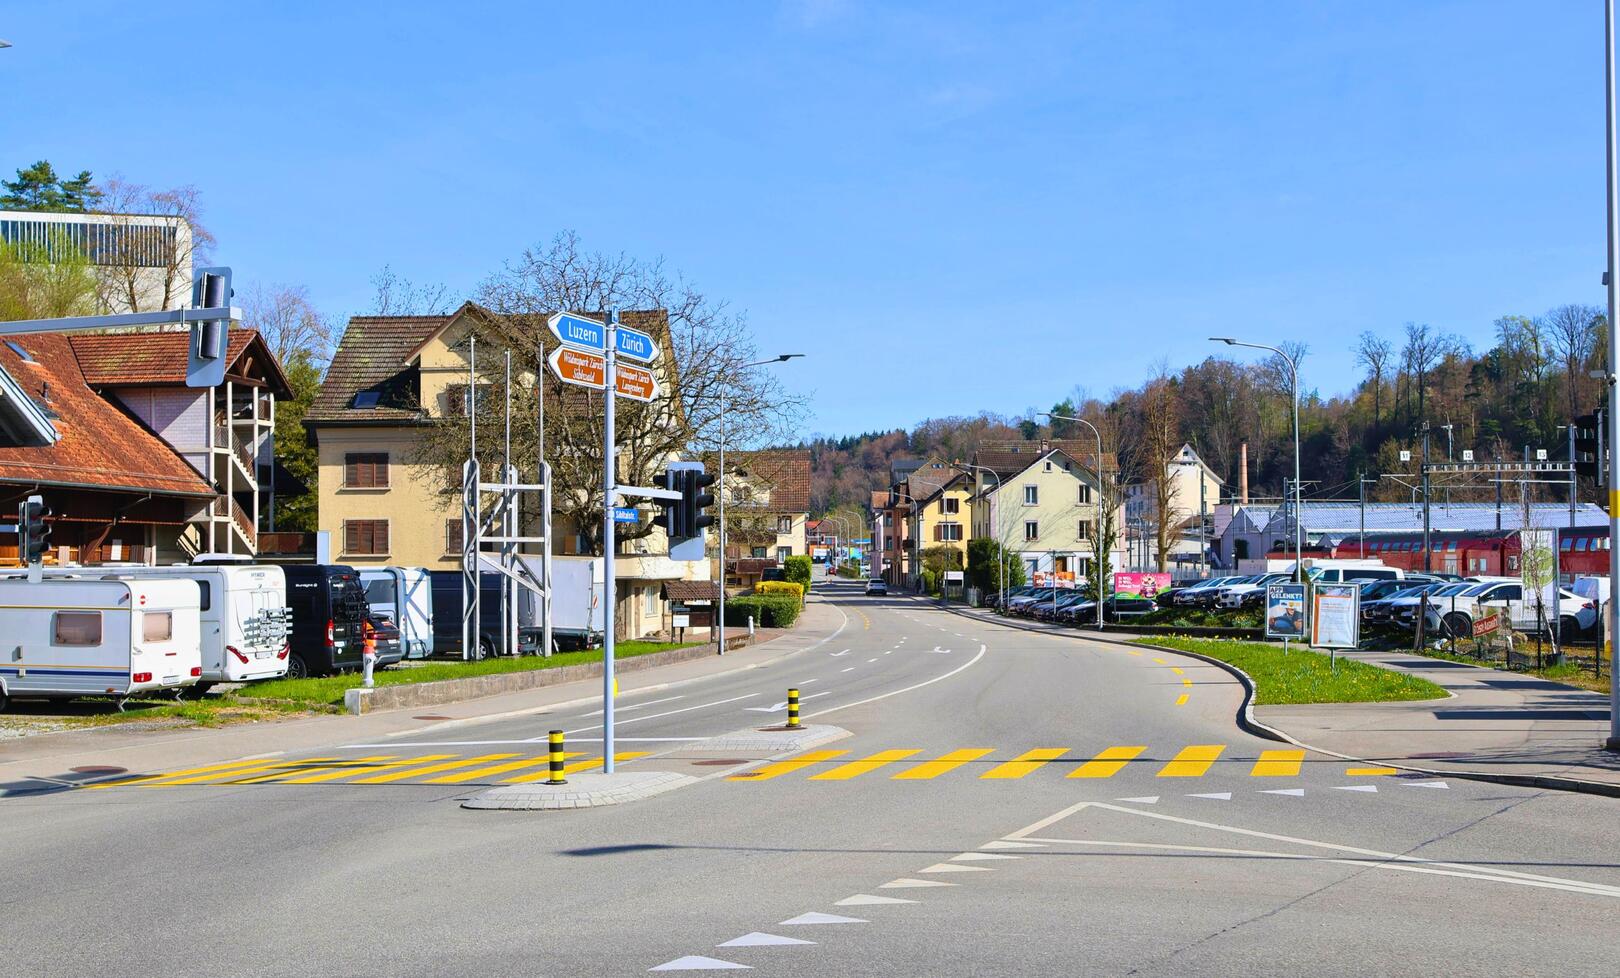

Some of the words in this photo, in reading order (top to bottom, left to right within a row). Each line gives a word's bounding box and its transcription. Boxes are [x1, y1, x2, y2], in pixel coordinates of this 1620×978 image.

[568, 321, 598, 343] Luzern
[621, 333, 644, 354] Zürich
[589, 357, 603, 370] Zürich
